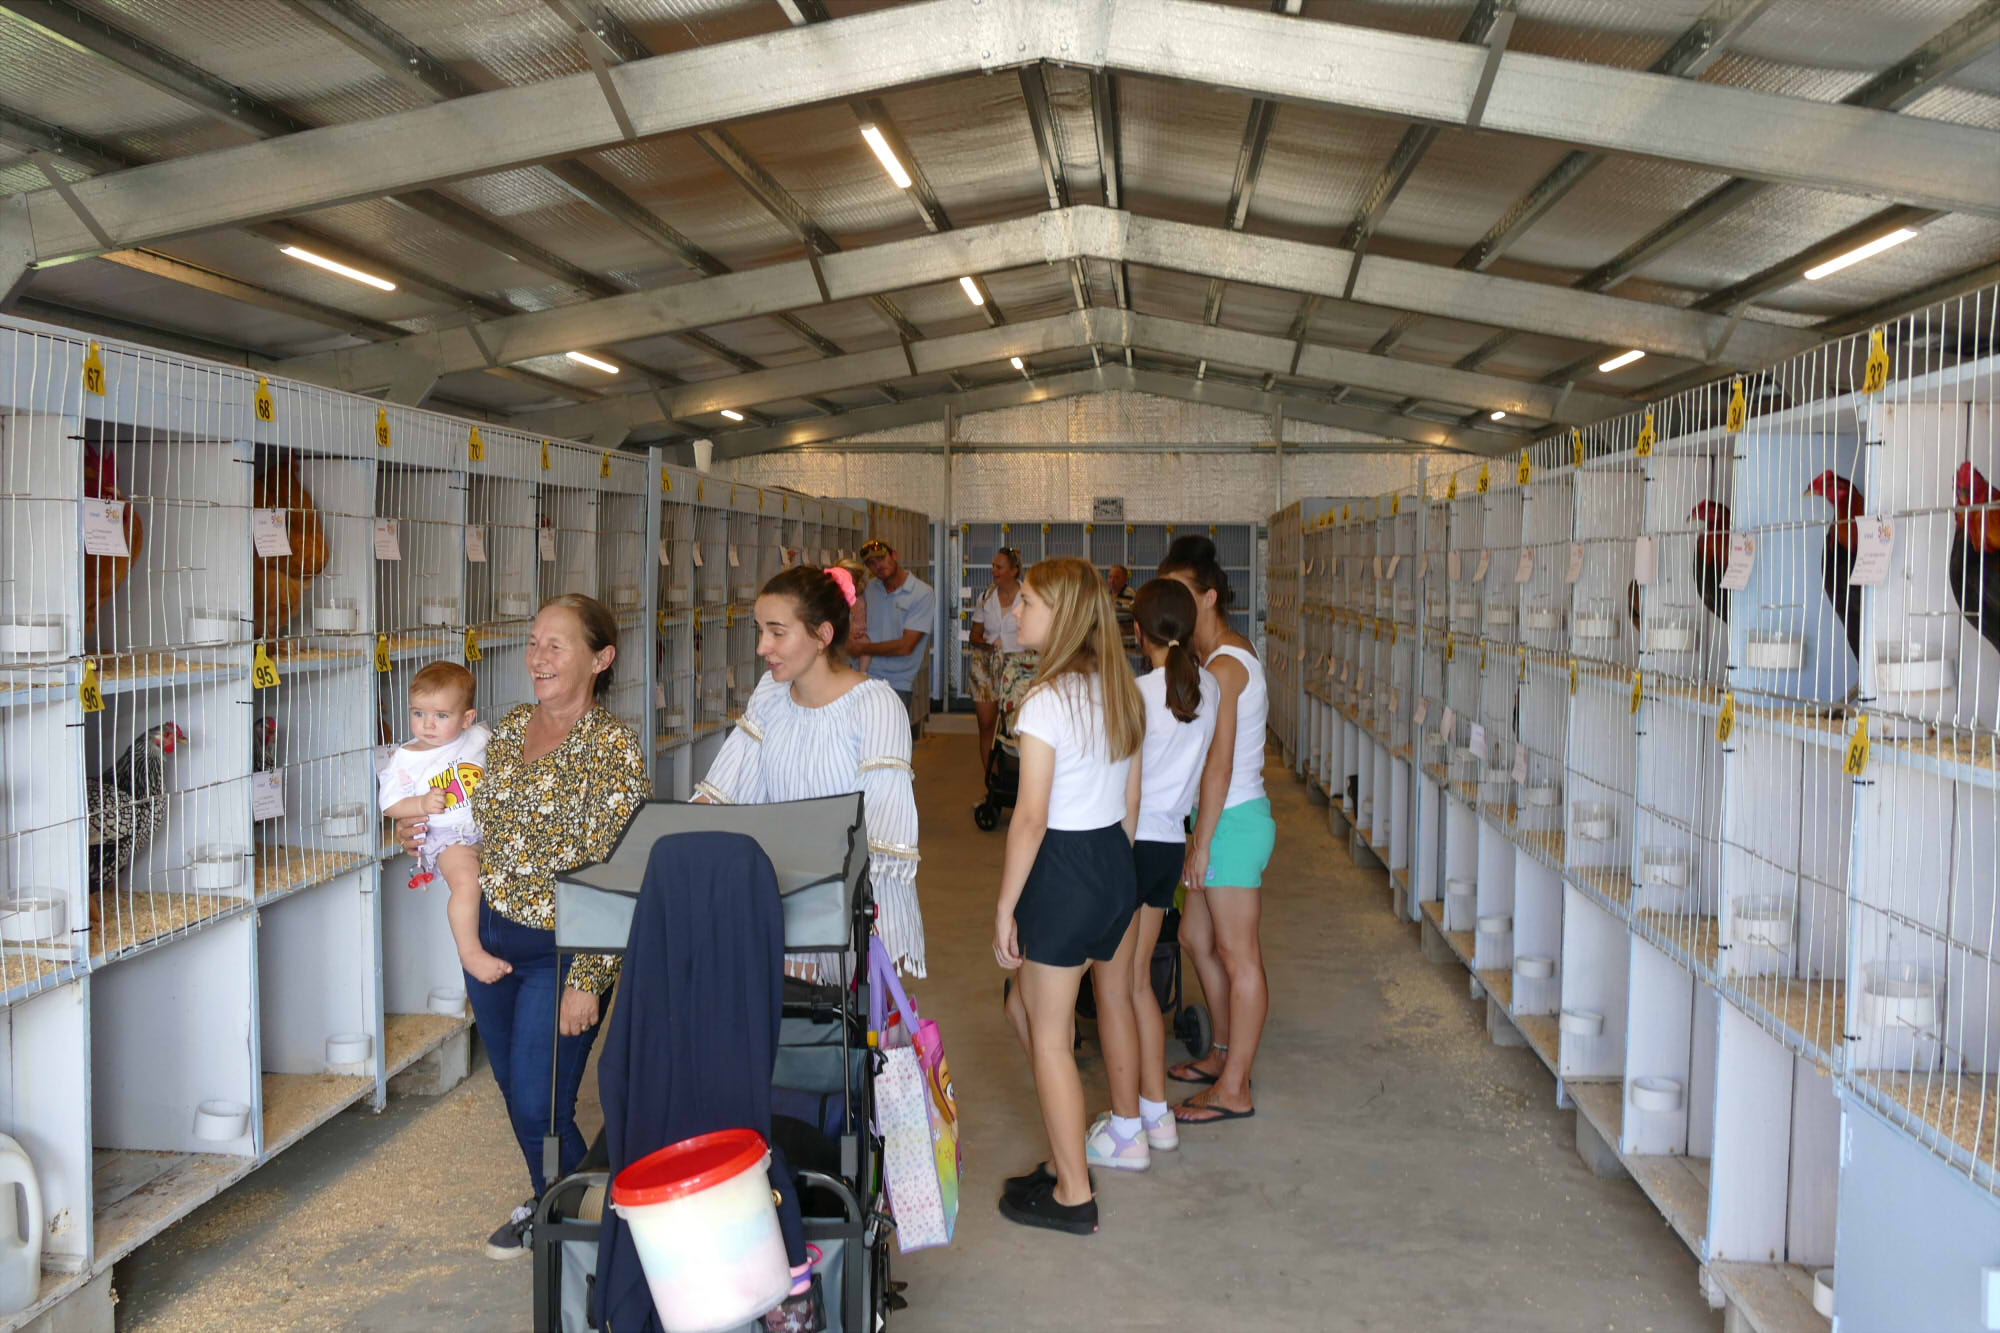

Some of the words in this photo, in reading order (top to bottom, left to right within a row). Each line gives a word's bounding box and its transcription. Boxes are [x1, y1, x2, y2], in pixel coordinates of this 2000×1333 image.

[87, 367, 100, 392] 67
[1868, 362, 1882, 391] 33
[259, 398, 270, 420] 68
[1730, 407, 1742, 430] 34
[379, 427, 388, 445] 69
[1639, 435, 1651, 455] 35
[1479, 478, 1488, 492] 38
[1520, 468, 1529, 484] 37
[378, 653, 388, 670] 94
[256, 665, 274, 686] 95
[84, 686, 98, 710] 96
[1848, 744, 1864, 774] 64
